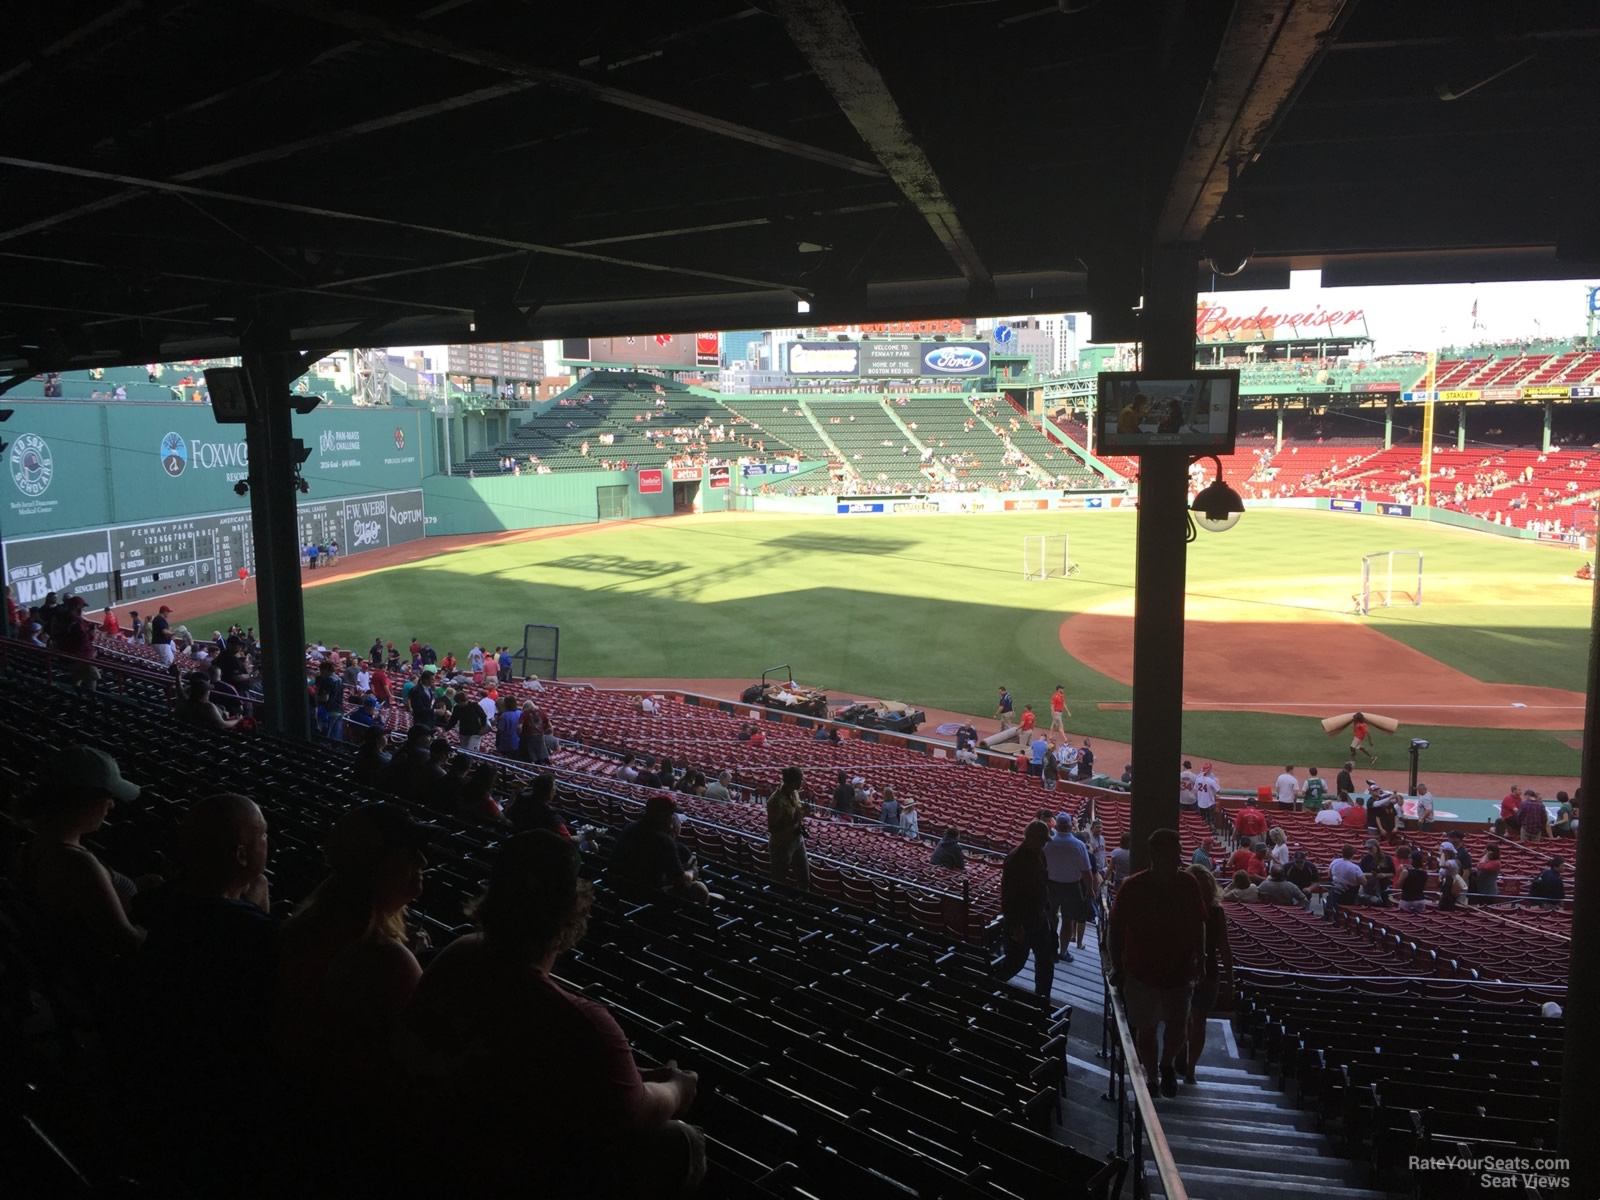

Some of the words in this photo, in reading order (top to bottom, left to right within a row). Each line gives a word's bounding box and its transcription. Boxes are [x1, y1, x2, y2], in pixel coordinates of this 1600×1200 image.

[1196, 304, 1363, 336] Budweiser
[937, 350, 974, 368] Ford
[336, 431, 360, 440] PAN-MASS
[12, 440, 26, 463] RED
[26, 436, 44, 452] SOX
[336, 442, 360, 450] CHALLENGE
[676, 470, 698, 478] aetna
[346, 504, 362, 520] F.W.
[362, 500, 386, 516] WEBB
[398, 508, 422, 525] OPTUM
[220, 516, 244, 524] AMERICAN
[132, 526, 166, 536] FENWAY
[172, 522, 194, 532] PARK
[127, 559, 145, 569] BOSTON
[160, 554, 178, 563] 2016
[10, 567, 28, 580] WHO
[28, 564, 42, 576] BUT
[142, 576, 154, 584] BALL
[158, 571, 174, 580] STRIKE
[176, 569, 186, 578] OUT
[74, 583, 95, 594] SINCE
[129, 578, 138, 586] BAT
[1180, 782, 1193, 792] 34
[1198, 783, 1208, 792] 24
